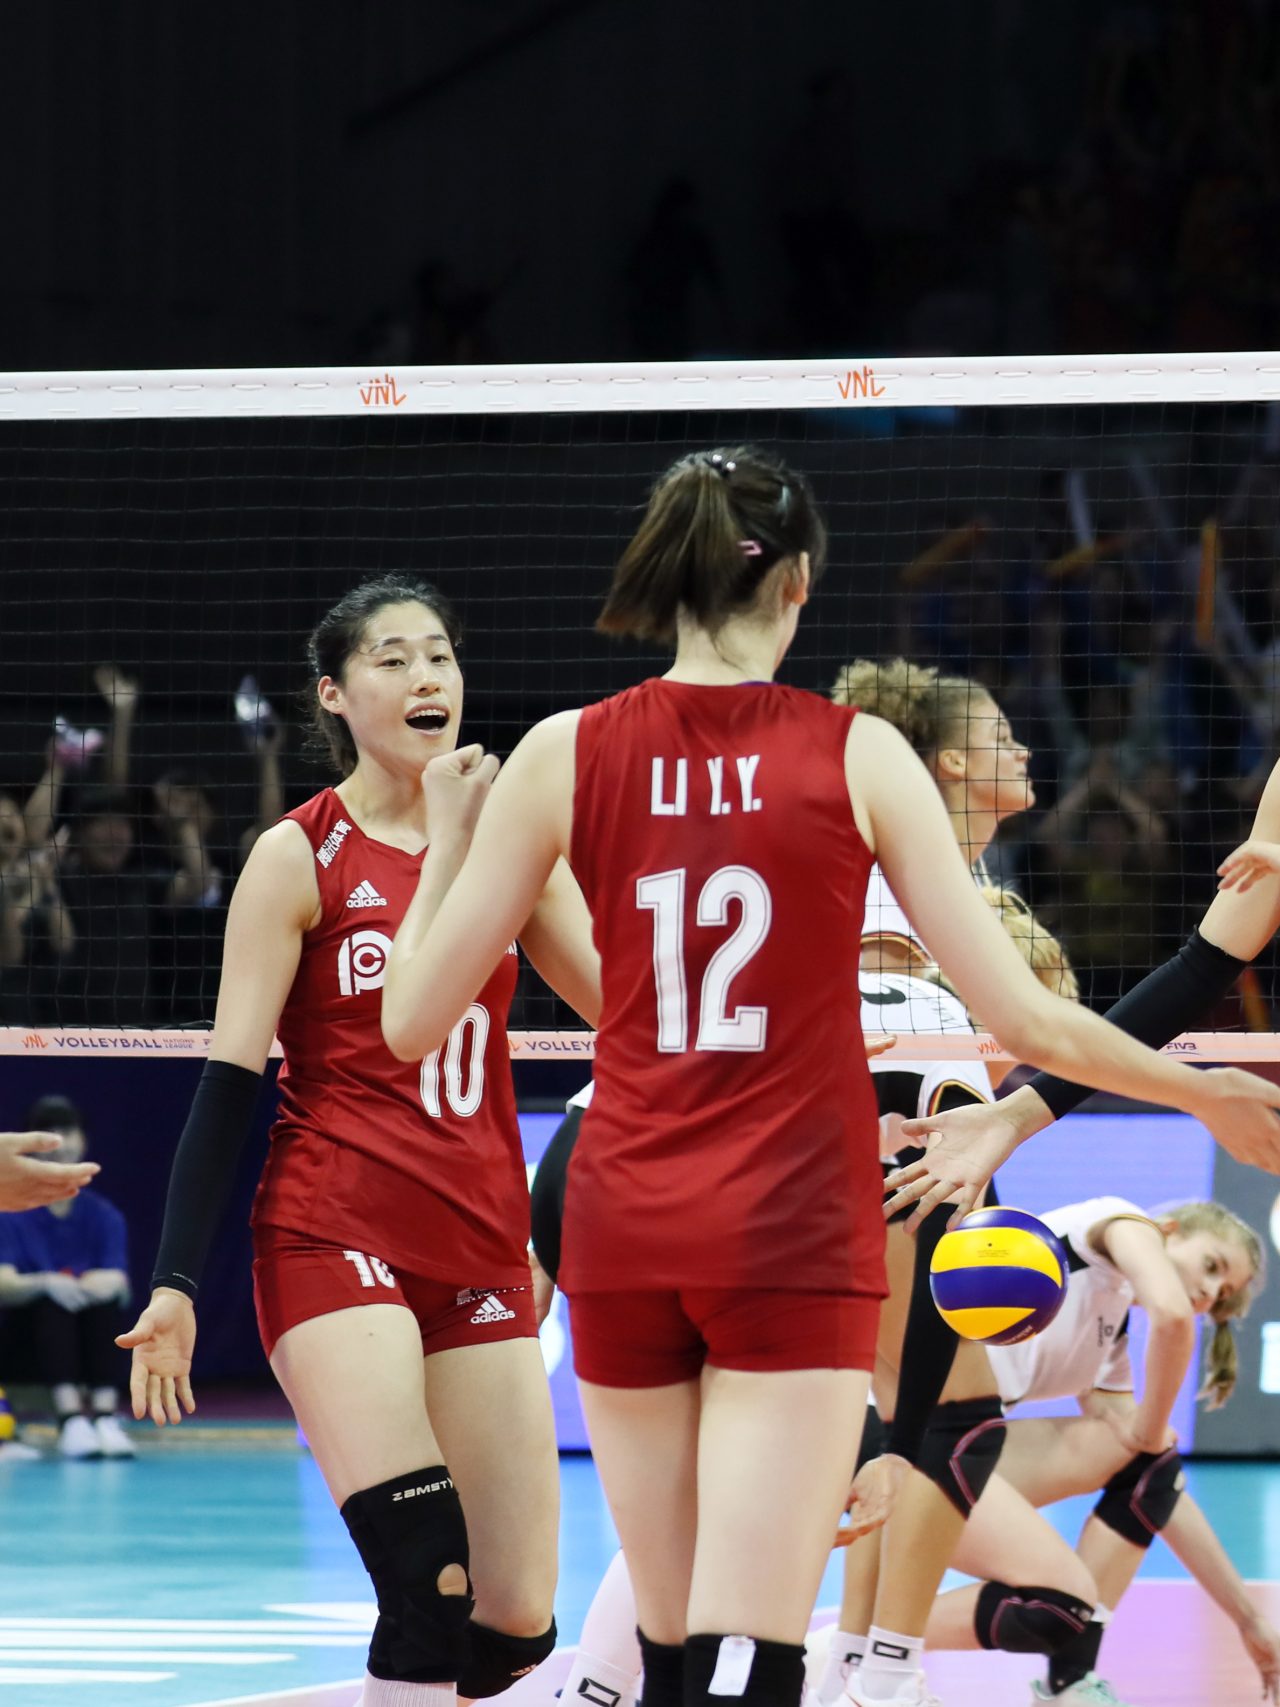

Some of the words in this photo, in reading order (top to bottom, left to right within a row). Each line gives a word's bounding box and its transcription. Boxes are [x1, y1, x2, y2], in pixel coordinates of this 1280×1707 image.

[360, 374, 407, 405] VNL
[838, 366, 886, 399] VNL
[651, 757, 688, 816] LI
[346, 897, 387, 909] adidas
[636, 865, 772, 1053] 12
[21, 1033, 48, 1049] VNL
[53, 1037, 163, 1048] VOLLEYBALL
[525, 1041, 597, 1051] VOLLEY
[420, 1002, 490, 1118] 10
[470, 1310, 516, 1324] adidas
